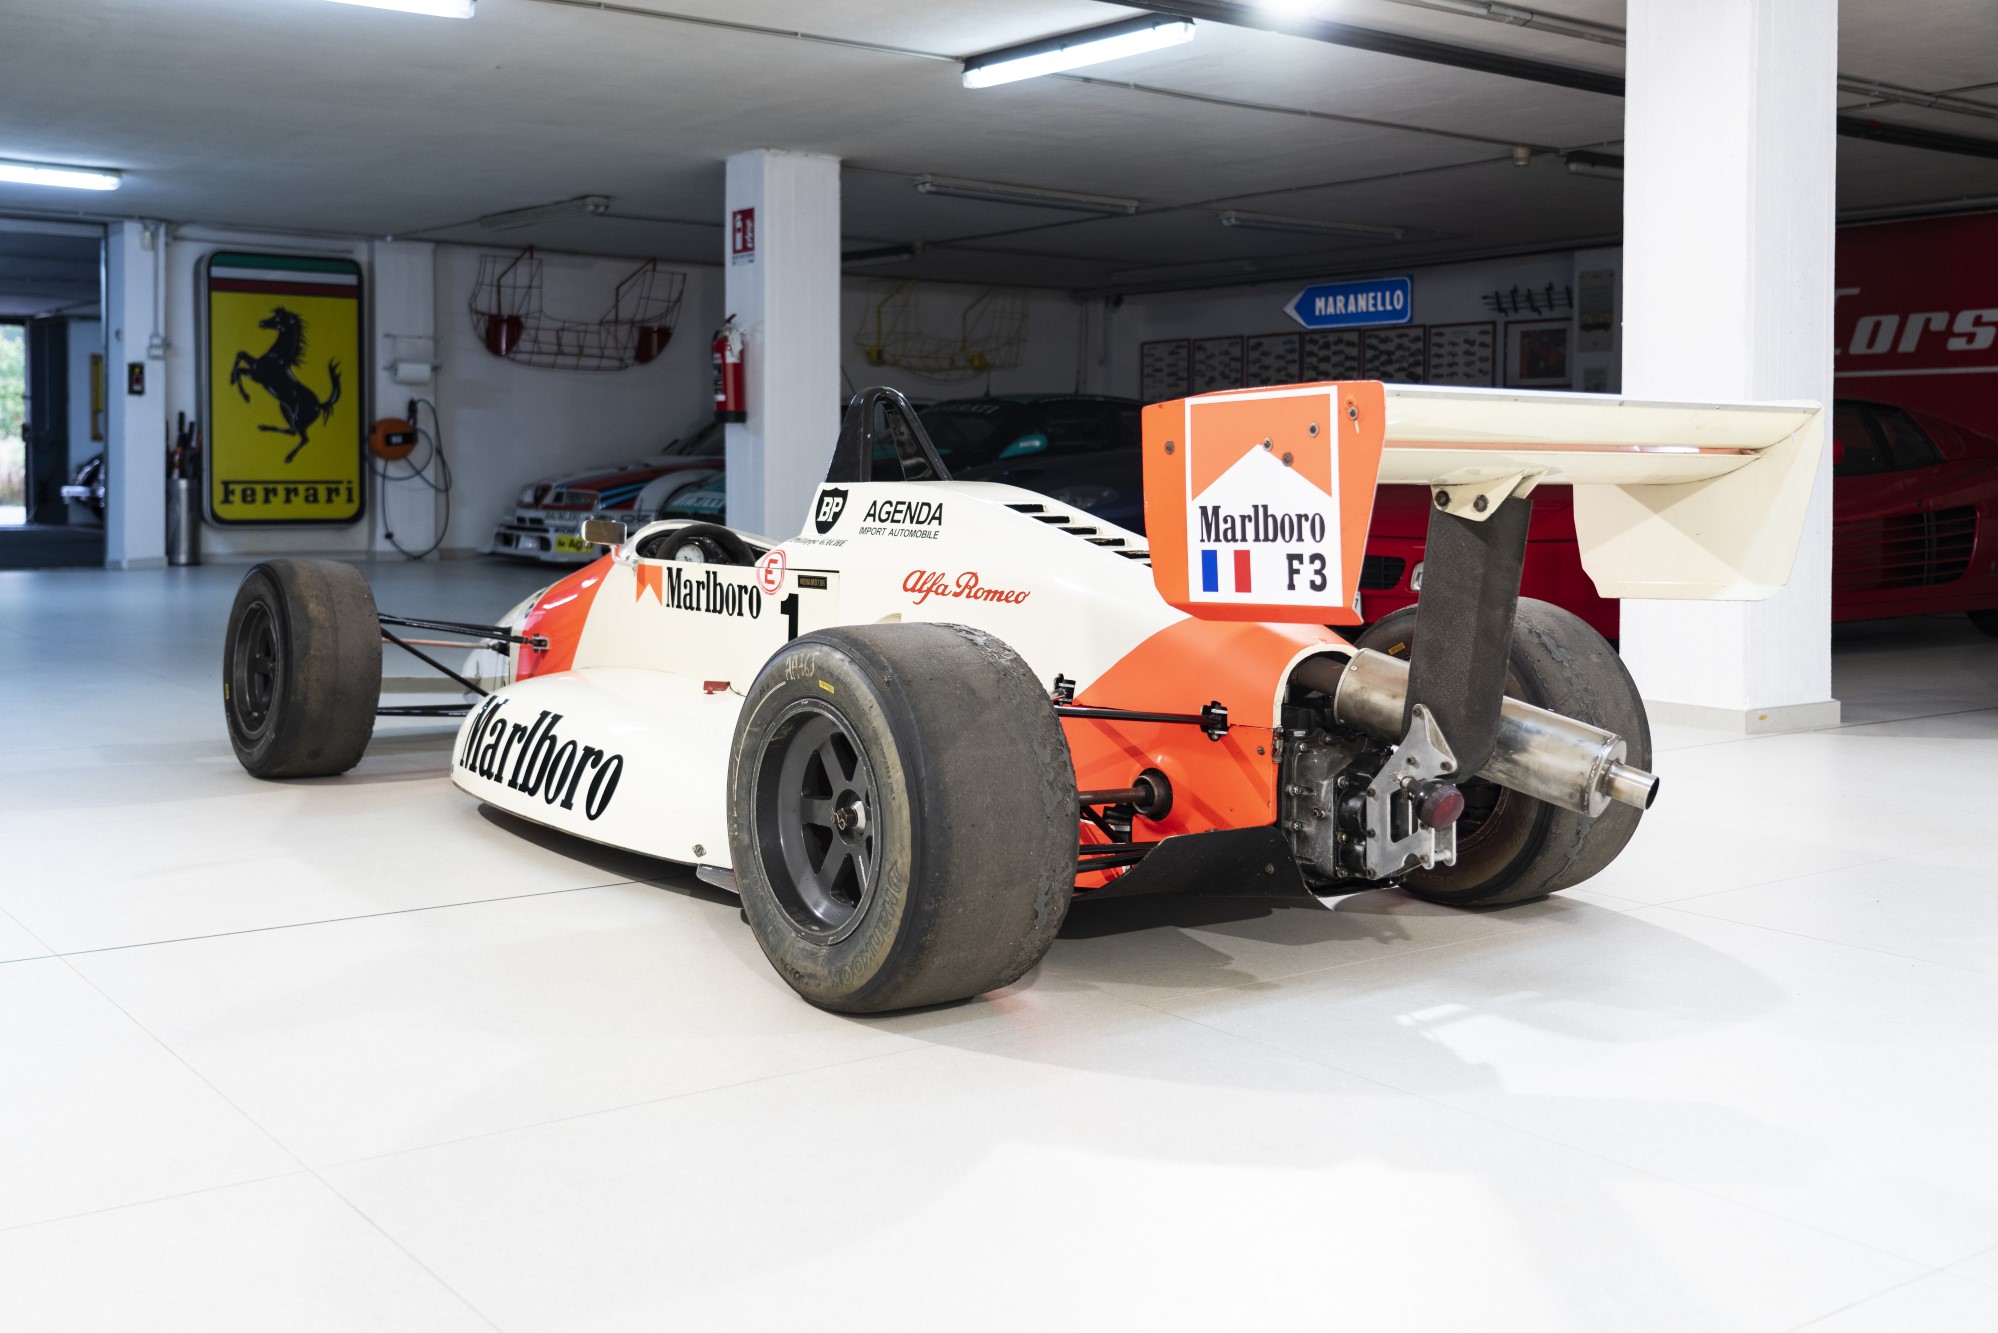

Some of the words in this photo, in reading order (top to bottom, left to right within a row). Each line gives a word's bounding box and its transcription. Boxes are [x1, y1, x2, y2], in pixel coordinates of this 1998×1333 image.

[1314, 288, 1404, 317] MARANELLO
[1834, 288, 1998, 356] ors
[220, 480, 355, 505] Ferrari
[816, 497, 845, 522] BP
[863, 500, 943, 526] AGENDA
[1199, 505, 1326, 544] Marlboro
[858, 526, 887, 536] IMPORT
[888, 528, 939, 540] AUTOMOBILE
[764, 558, 778, 585] E
[902, 570, 952, 605] Alfa
[950, 571, 1030, 605] Romeo
[1286, 552, 1328, 592] F3
[666, 567, 762, 619] Marlboro
[780, 593, 799, 645] 1
[460, 695, 624, 821] Marlboro
